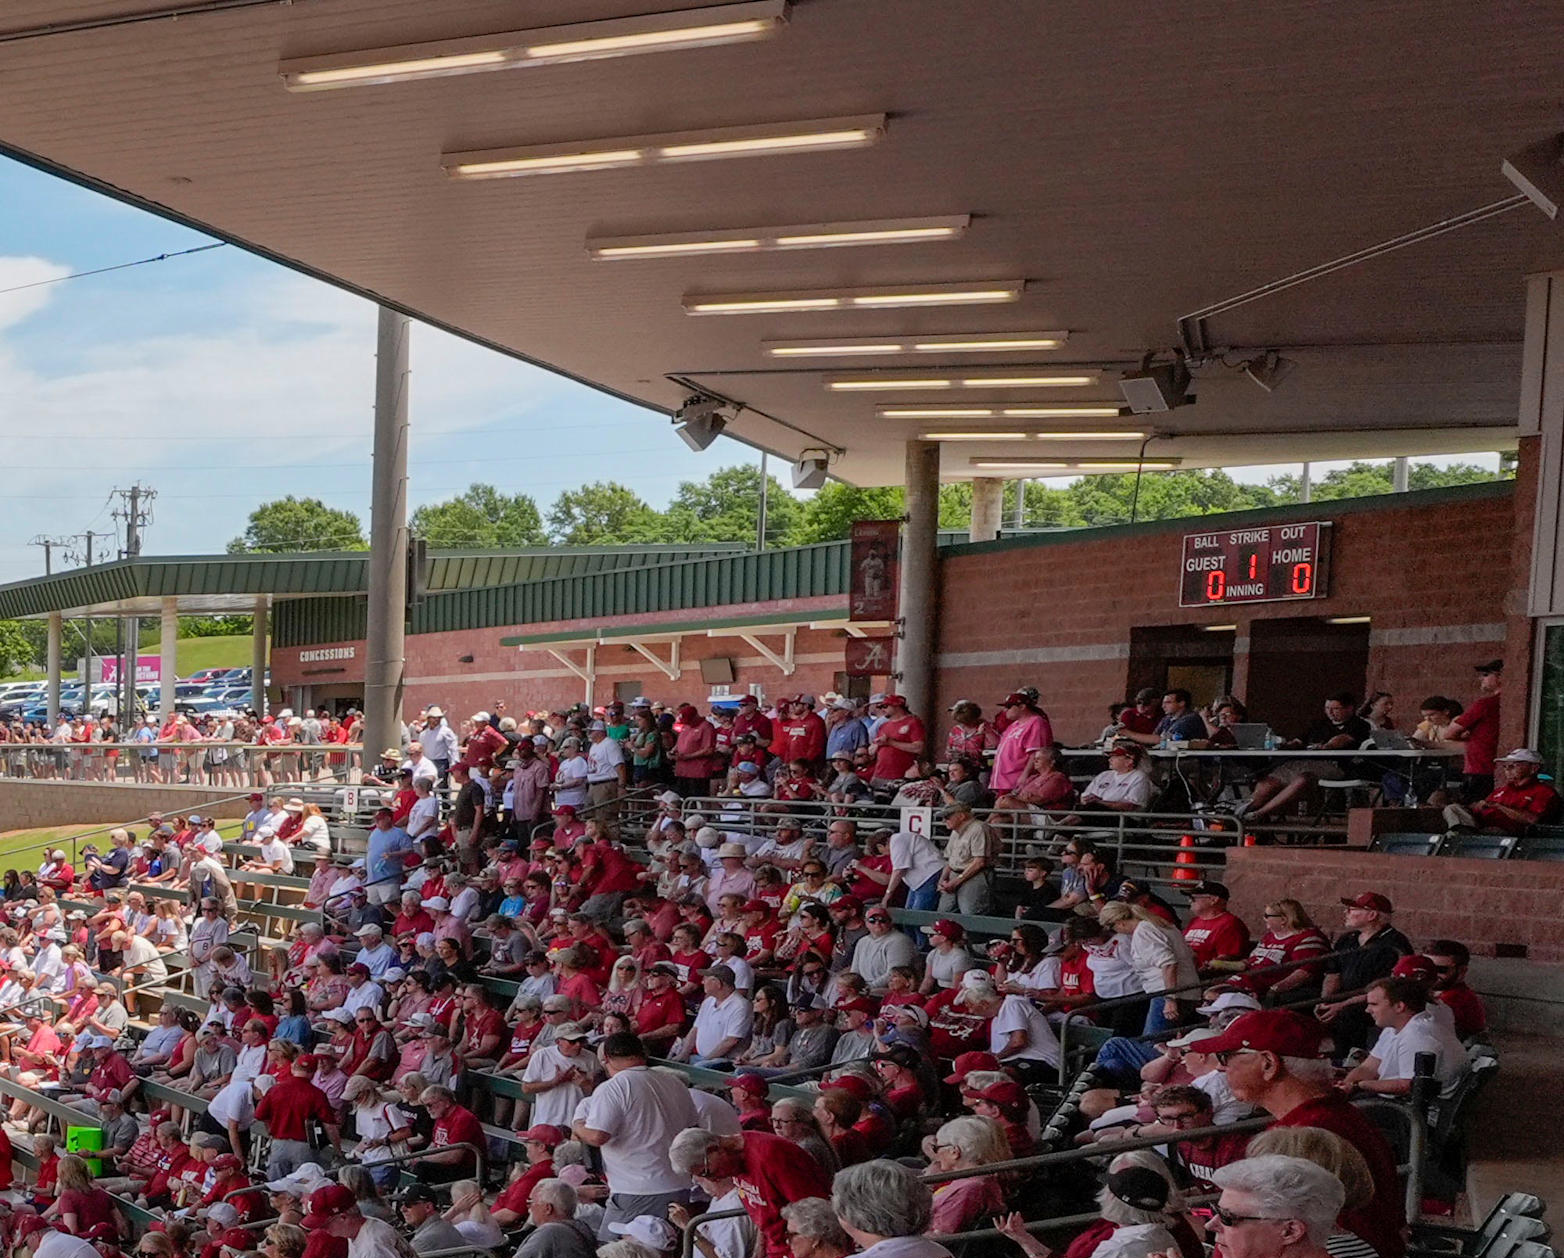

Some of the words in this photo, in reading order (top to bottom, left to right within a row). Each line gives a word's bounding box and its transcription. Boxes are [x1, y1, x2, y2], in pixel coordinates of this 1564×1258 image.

[1194, 536, 1219, 549] BALL
[1229, 530, 1269, 545] STRIKE
[1281, 526, 1306, 540] OUT
[1186, 556, 1225, 572] GUEST
[1272, 548, 1312, 564] HOME
[1249, 554, 1257, 579] 1
[1206, 570, 1225, 600] 0
[1226, 583, 1264, 597] INNING
[1292, 563, 1311, 594] 0
[300, 647, 355, 662] CONCESSIONS
[910, 815, 922, 833] C
